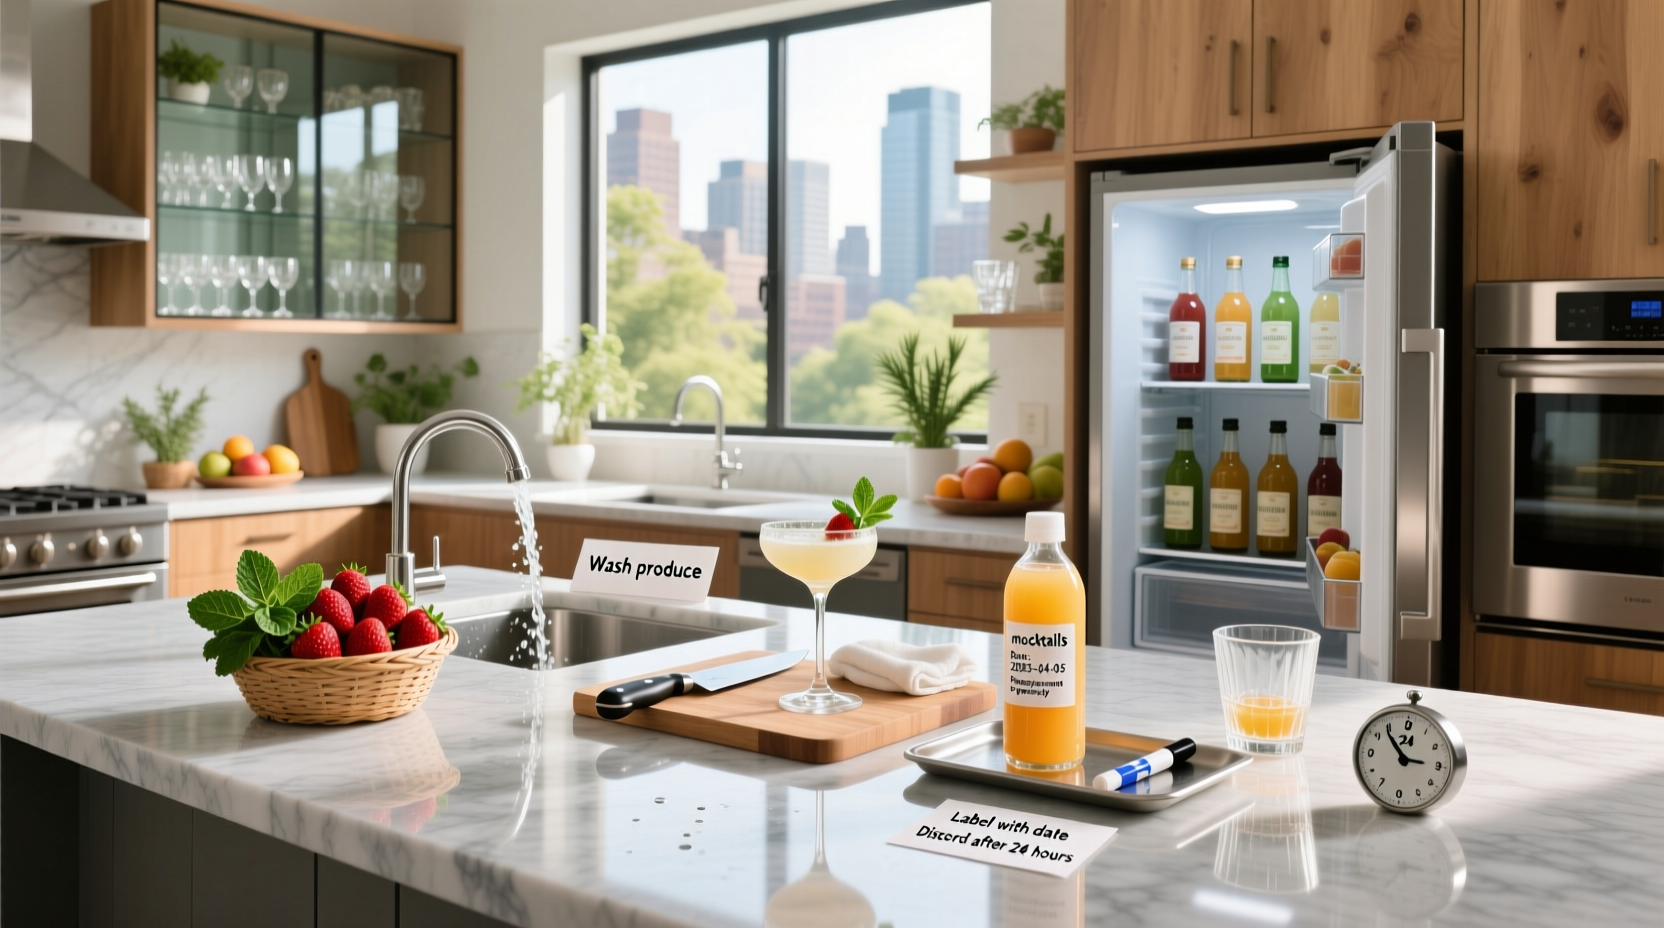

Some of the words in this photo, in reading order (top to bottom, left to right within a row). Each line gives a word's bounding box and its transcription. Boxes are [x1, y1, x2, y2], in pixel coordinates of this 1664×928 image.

[590, 555, 632, 574] Wash
[635, 560, 702, 580] produce
[950, 811, 996, 828] Label
[997, 819, 1030, 835] with
[1032, 824, 1069, 841] date
[970, 835, 1008, 851] after
[1031, 845, 1074, 864] hours
